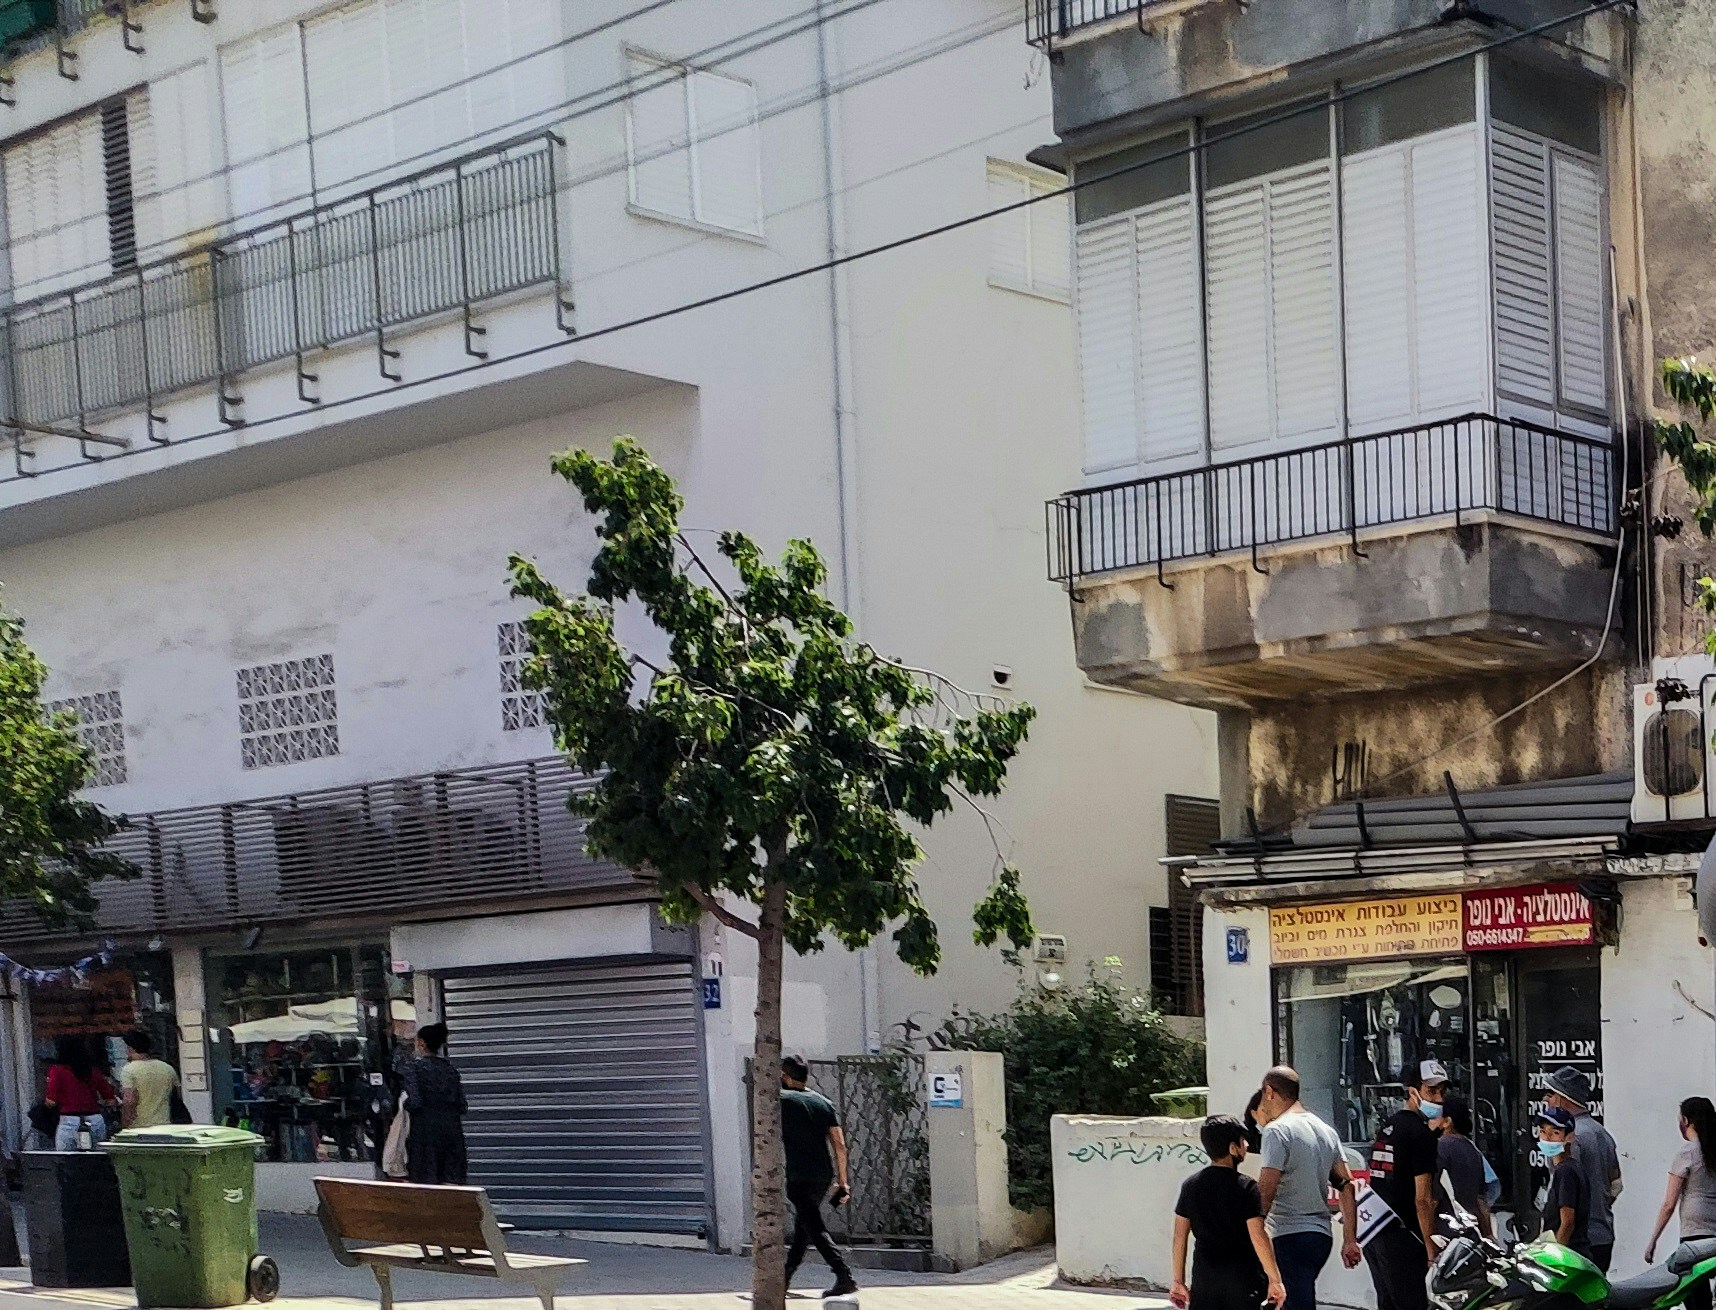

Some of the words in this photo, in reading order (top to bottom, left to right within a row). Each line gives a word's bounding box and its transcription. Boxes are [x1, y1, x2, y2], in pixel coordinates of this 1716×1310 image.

[1356, 903, 1407, 921] עבודות
[1416, 899, 1458, 915] ביצוע
[1467, 898, 1492, 927] נופר
[1494, 896, 1515, 925] אבי
[1522, 888, 1591, 924] אינסטלציה
[1272, 907, 1346, 928] אינסטלציה
[1307, 929, 1327, 941] מים
[1336, 925, 1367, 939] צנרת
[1375, 919, 1420, 936] והחלפת
[1429, 918, 1458, 936] תיקון
[1228, 933, 1246, 956] 30
[1273, 931, 1300, 944] וביוב
[1421, 935, 1458, 950] פתיחת
[1537, 1040, 1567, 1057] נופר
[1570, 1040, 1596, 1057] אבי
